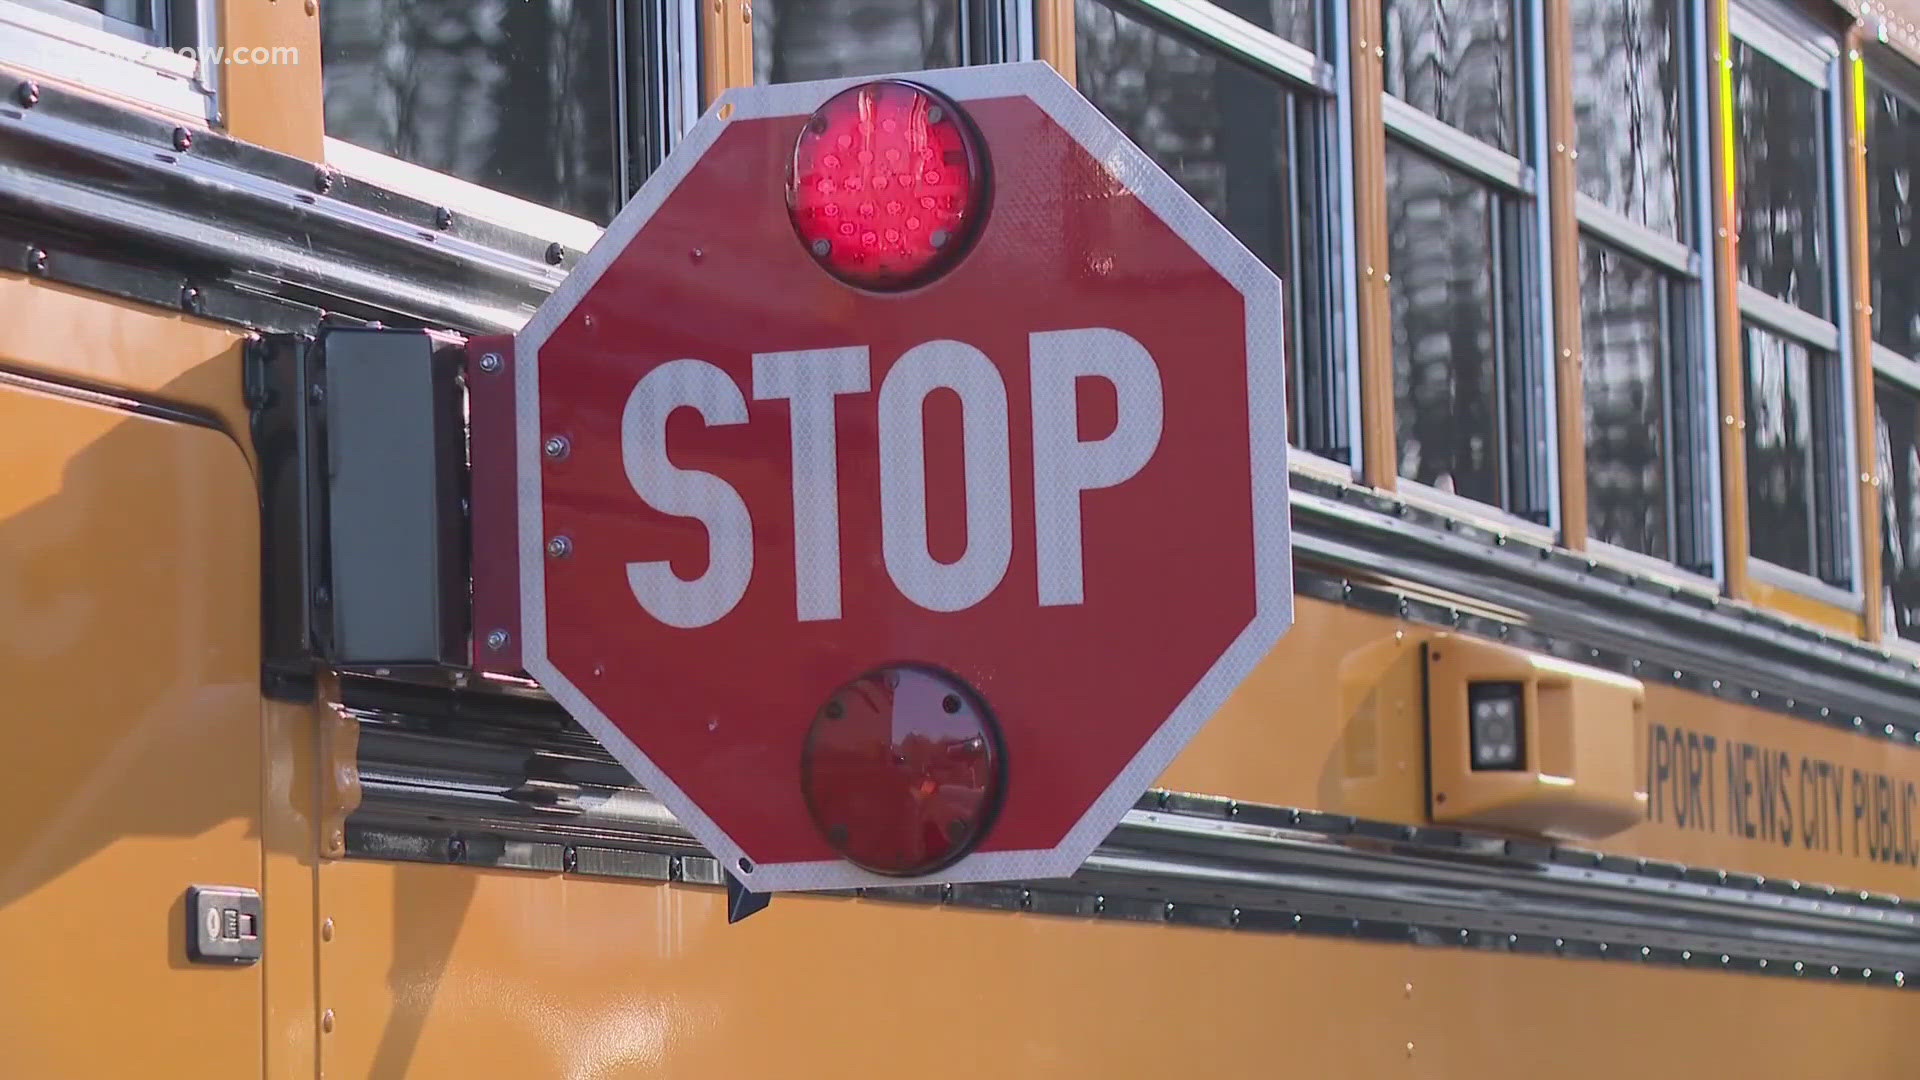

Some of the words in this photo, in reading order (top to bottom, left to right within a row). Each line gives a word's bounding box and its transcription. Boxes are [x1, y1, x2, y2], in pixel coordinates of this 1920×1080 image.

[621, 327, 1164, 629] STOP
[1647, 722, 1717, 833] PORT
[1726, 739, 1793, 847] NEWS
[1801, 755, 1844, 855] CITY
[1852, 767, 1920, 869] PUBLIC
